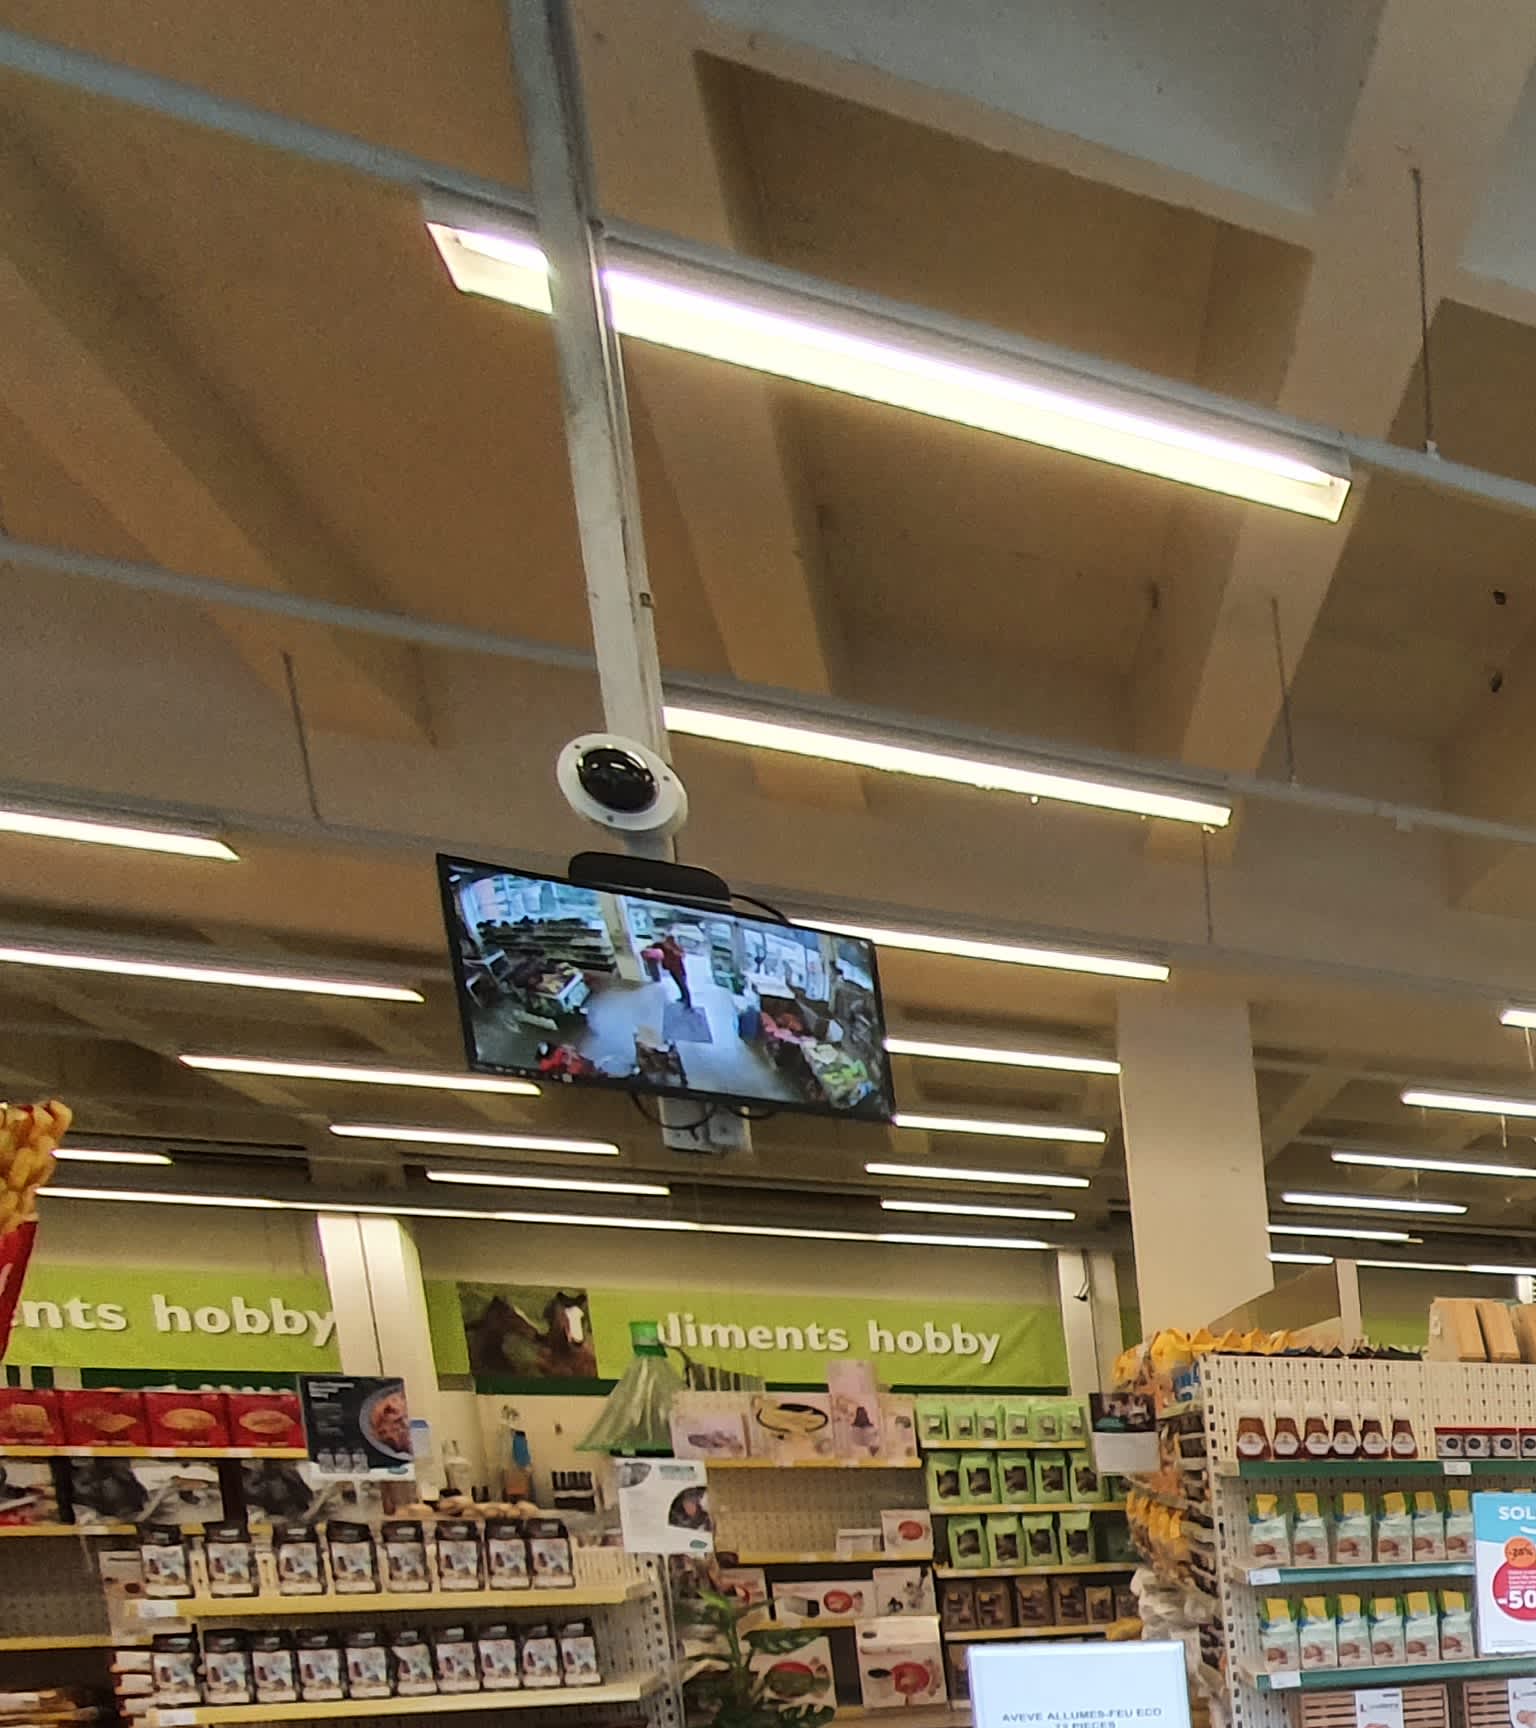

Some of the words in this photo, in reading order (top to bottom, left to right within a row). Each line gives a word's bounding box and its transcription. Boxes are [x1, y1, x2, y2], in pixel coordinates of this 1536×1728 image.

[11, 1296, 128, 1331] nts
[152, 1294, 337, 1347] hobby
[868, 1320, 1001, 1364] hobby
[1002, 1711, 1044, 1722] AVEVE
[1047, 1708, 1134, 1722] ALLUMES-FEU
[1136, 1707, 1163, 1718] ECO
